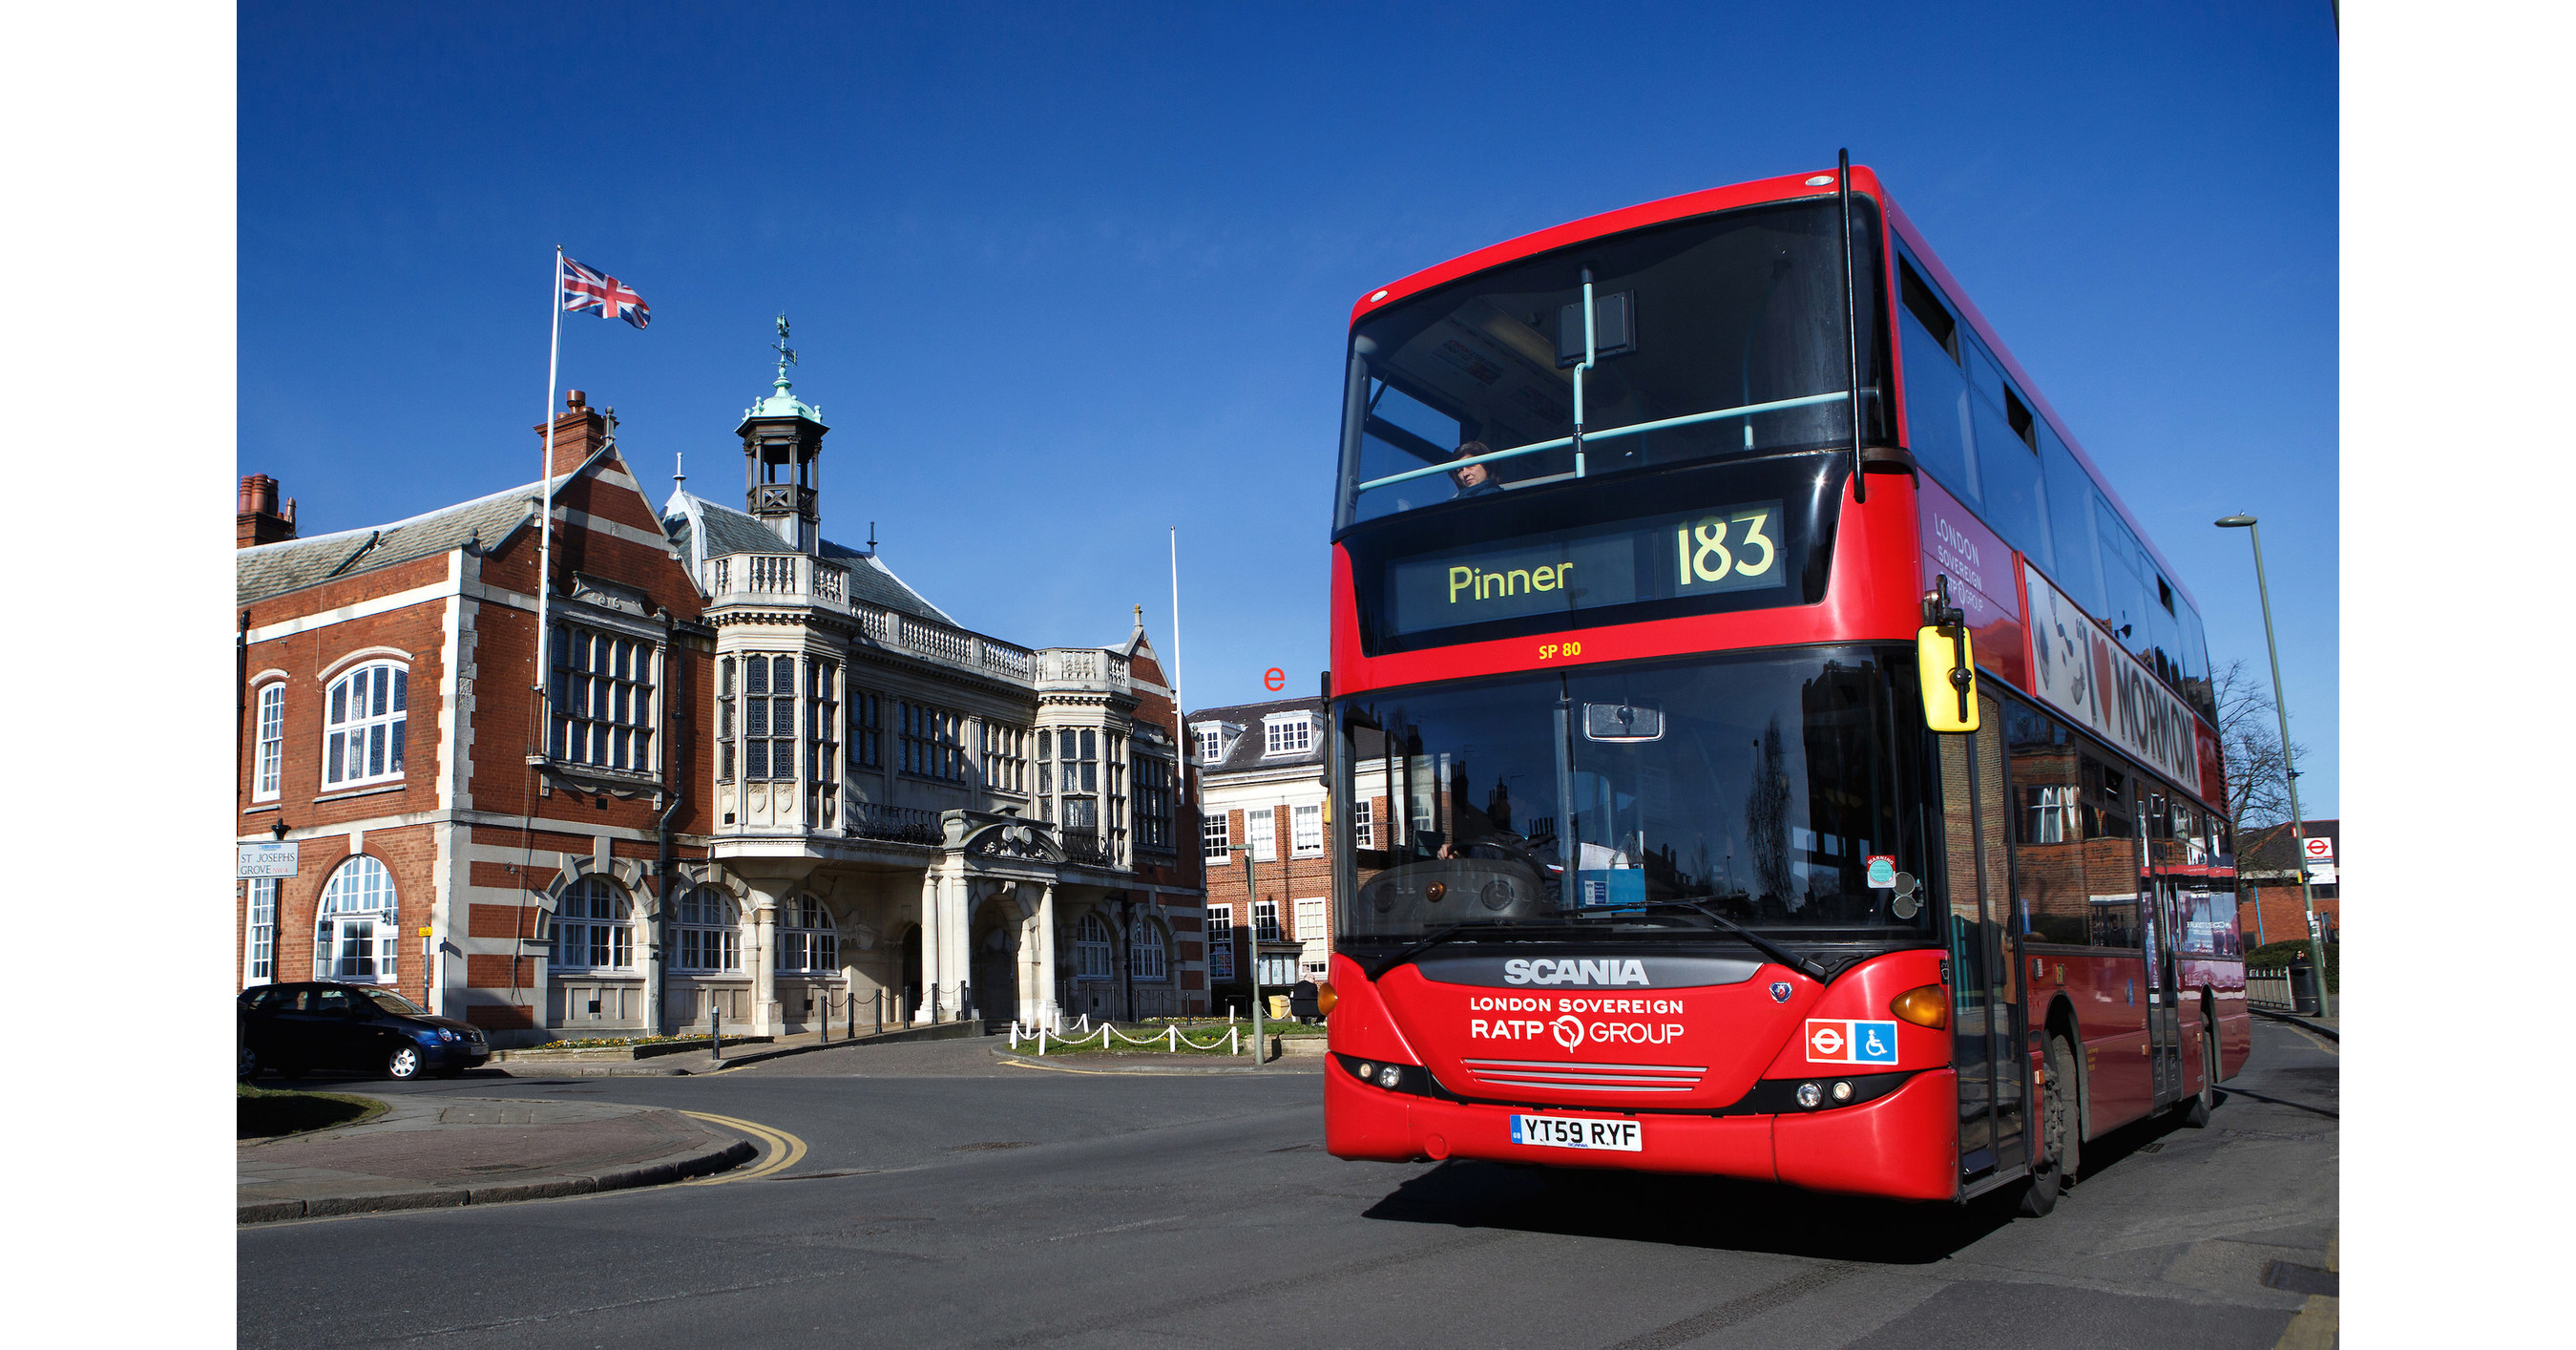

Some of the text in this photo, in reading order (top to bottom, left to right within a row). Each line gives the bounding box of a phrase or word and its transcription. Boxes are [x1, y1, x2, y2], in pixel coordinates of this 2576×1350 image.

[1677, 507, 1774, 585] 183
[1934, 513, 1979, 567] LONDON
[1937, 544, 1982, 591] SOVEREIGN
[1449, 561, 1573, 603] Pinner
[1539, 642, 1581, 660] SP 80
[241, 852, 295, 863] ST JOSEPHS
[241, 864, 271, 875] GROVE
[1868, 856, 1894, 865] WARNING
[1504, 959, 1650, 985] SCANIA
[1471, 997, 1684, 1014] LONDON SOVEREIGN
[1471, 1019, 1685, 1044] RATP GROUP
[1525, 1118, 1637, 1146] YT59 RYF
